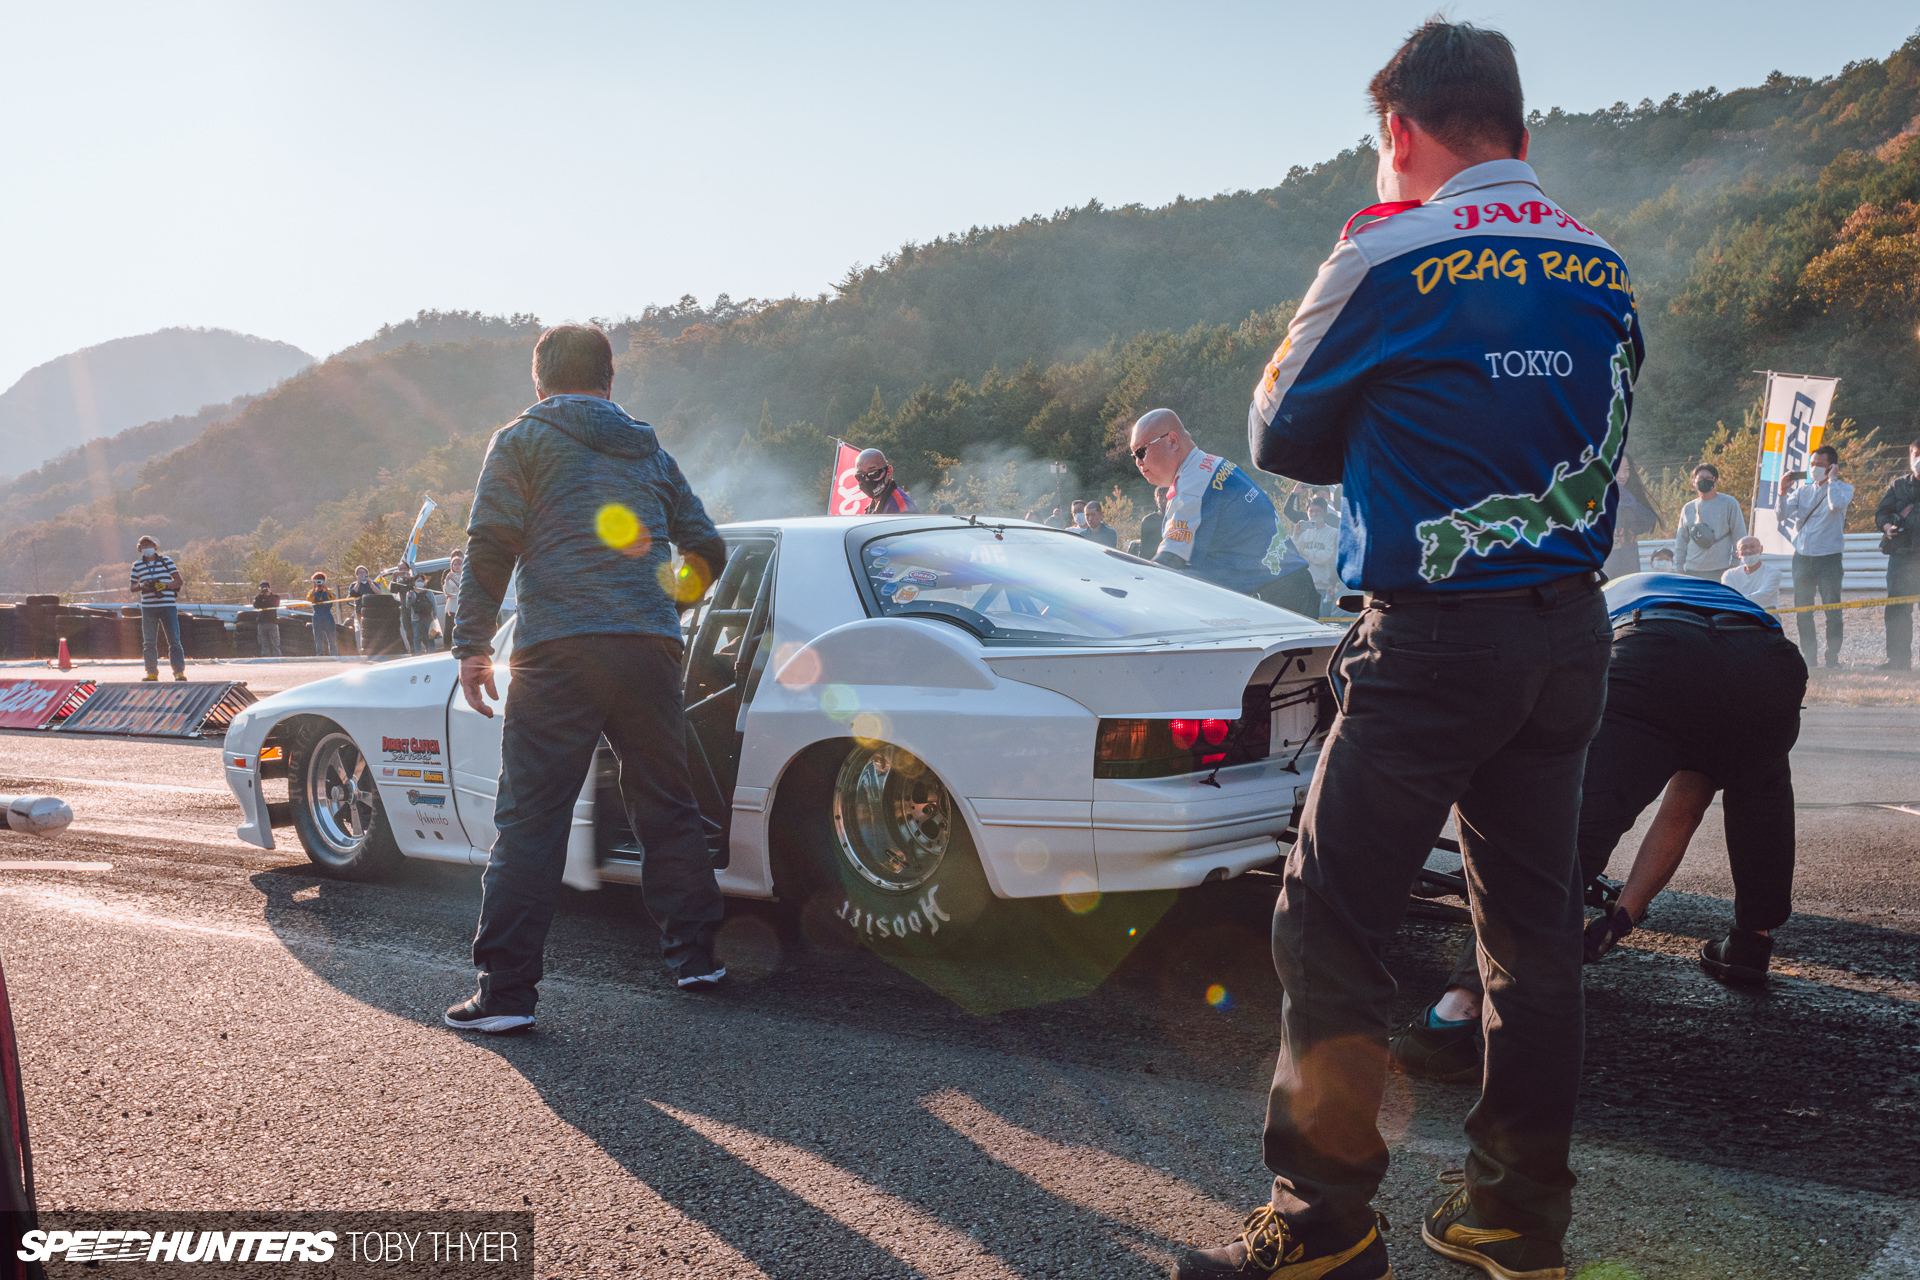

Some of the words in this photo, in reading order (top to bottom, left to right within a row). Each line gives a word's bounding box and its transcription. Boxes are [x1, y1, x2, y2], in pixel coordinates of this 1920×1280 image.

[1453, 200, 1594, 236] JAPA
[1411, 248, 1528, 294] DRAG
[1485, 350, 1573, 378] TOKYO
[119, 688, 187, 707] DRAG
[77, 710, 192, 732] FESTIVAL
[382, 736, 409, 753] DIRECT
[410, 737, 440, 755] CLUTCH
[836, 884, 951, 941] Hoosier
